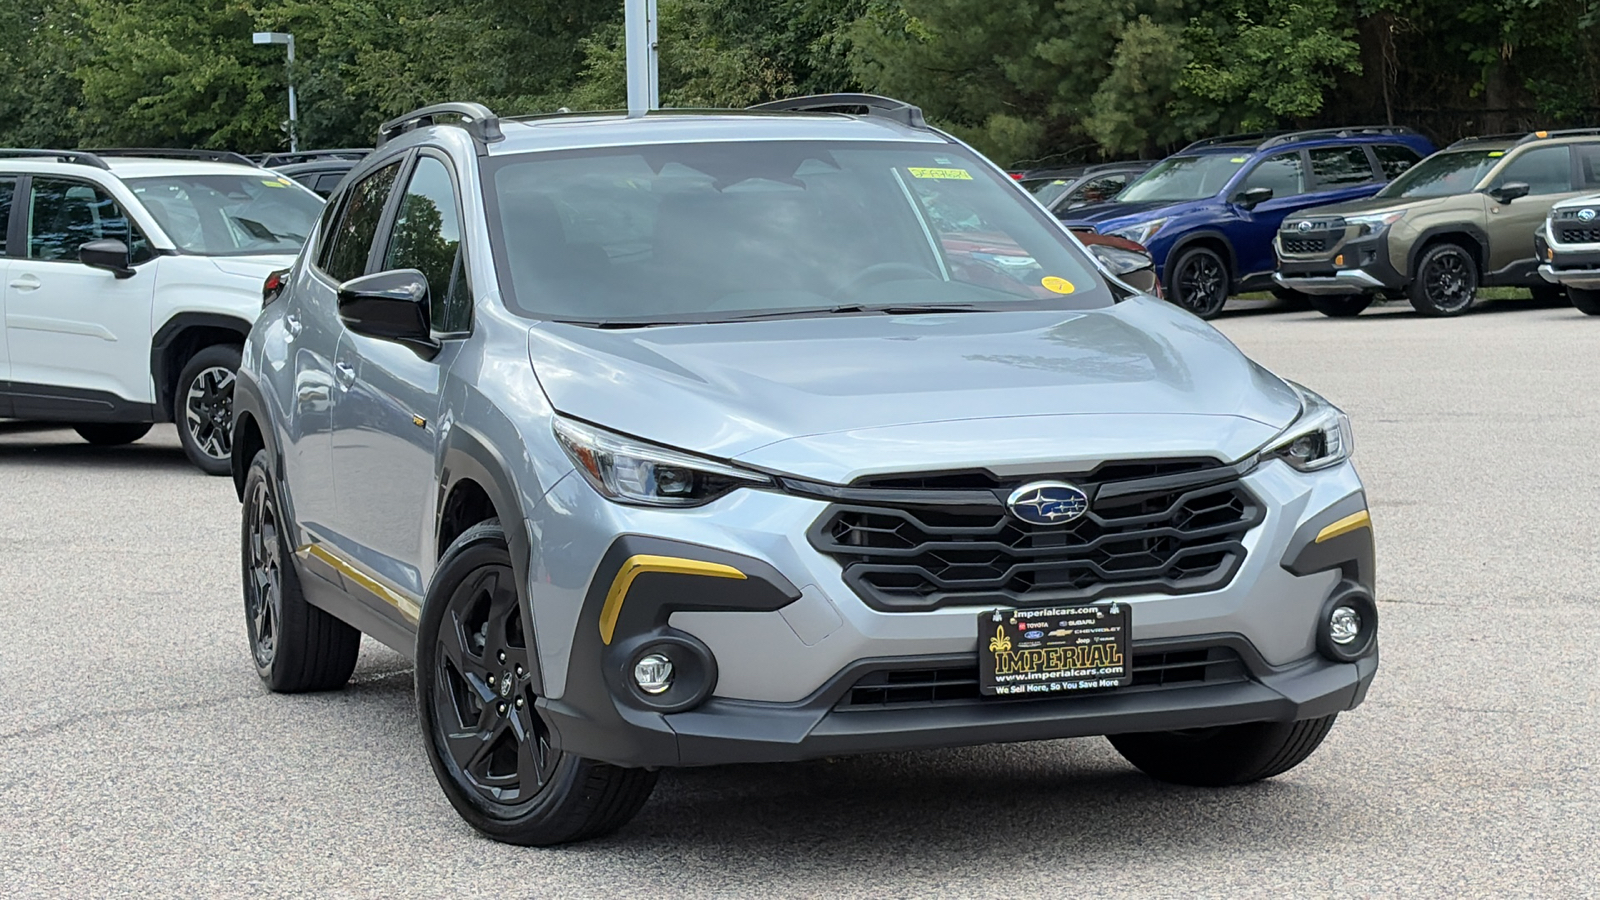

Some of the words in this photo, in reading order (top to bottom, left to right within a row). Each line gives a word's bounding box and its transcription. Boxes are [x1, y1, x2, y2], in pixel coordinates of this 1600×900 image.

[1068, 619, 1096, 627] SUBARU
[1074, 626, 1121, 634] CHEVROLET
[995, 643, 1123, 674] IMPERIAL
[995, 666, 1123, 682] www.imperialcars.com
[996, 686, 1009, 694] We
[1010, 685, 1026, 693] Sell
[1027, 684, 1049, 692] More,
[1050, 682, 1060, 691] So
[1061, 681, 1077, 689] You
[1079, 680, 1098, 688] Save
[1099, 679, 1119, 687] More
